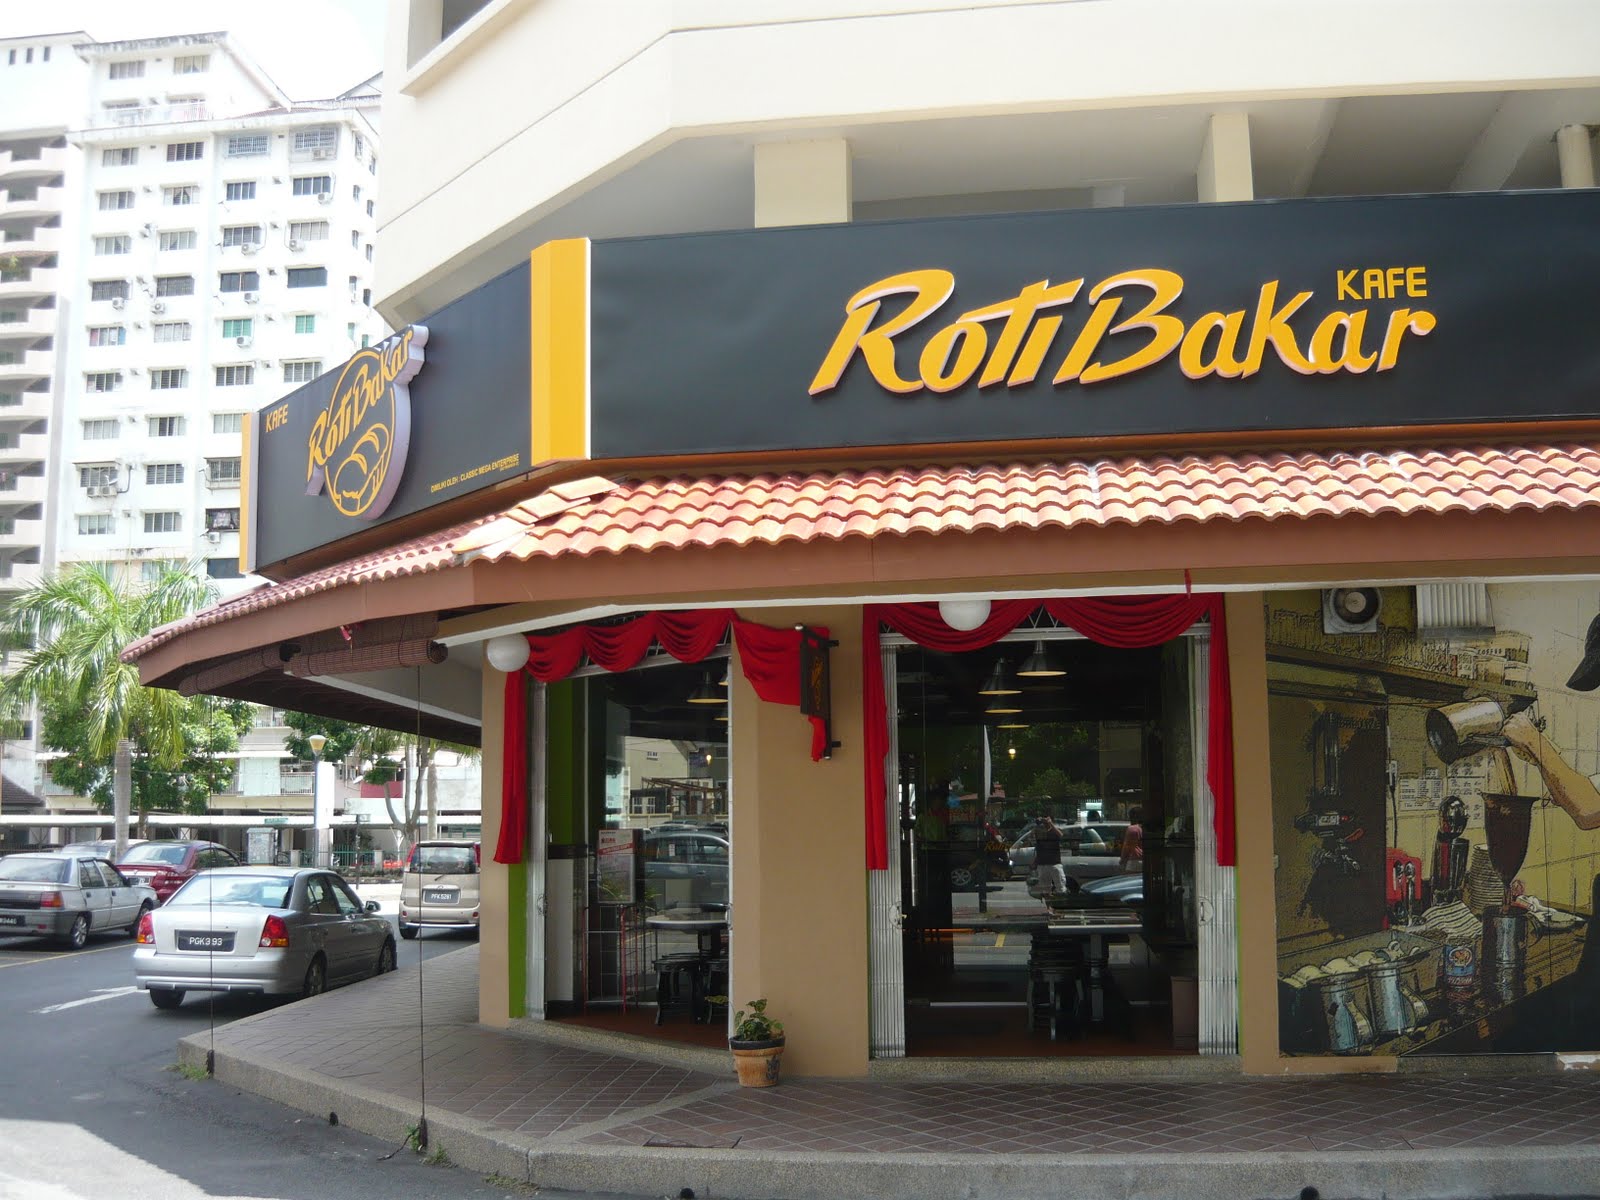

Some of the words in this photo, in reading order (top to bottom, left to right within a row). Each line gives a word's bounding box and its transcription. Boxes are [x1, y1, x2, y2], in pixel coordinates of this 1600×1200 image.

[1337, 266, 1428, 300] KAFE
[265, 403, 289, 433] KAFE
[460, 468, 479, 482] CLASSIC
[492, 453, 519, 470] ENTERPRISE
